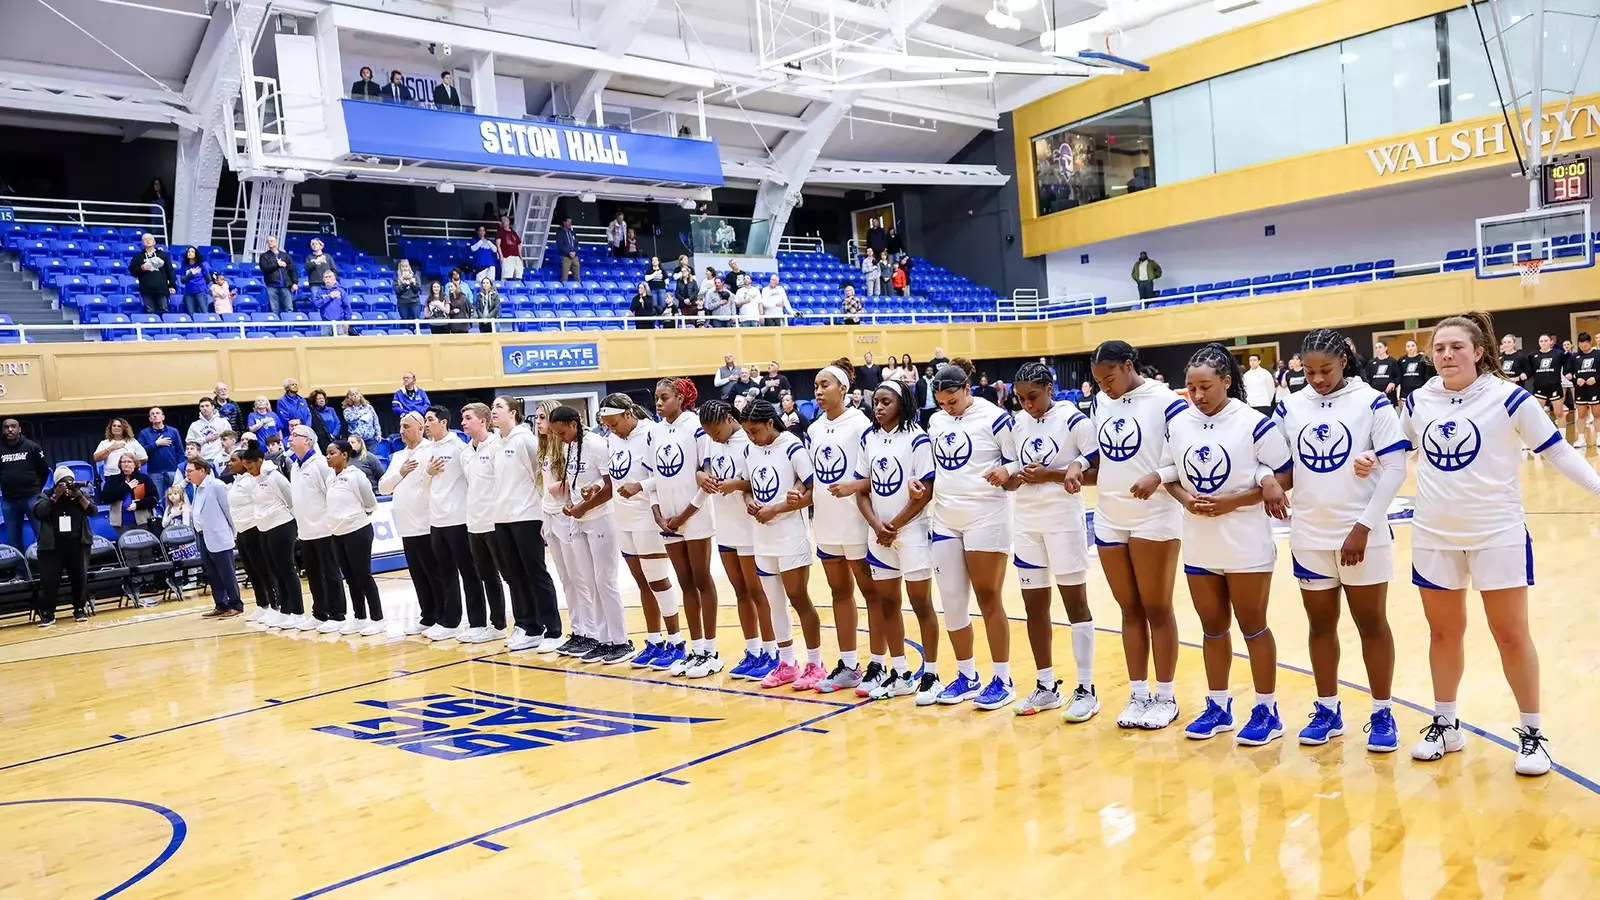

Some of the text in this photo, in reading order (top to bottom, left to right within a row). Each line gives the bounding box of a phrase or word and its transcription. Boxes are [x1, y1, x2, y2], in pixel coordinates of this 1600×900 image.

[479, 120, 629, 166] SETON HALL
[1365, 123, 1508, 177] WALSH
[1552, 162, 1585, 179] 10:00
[1553, 176, 1581, 200] 30
[1, 211, 12, 221] 15
[321, 225, 330, 234] 15
[525, 348, 594, 361] PIRATE
[526, 359, 595, 368] ATHLETICS
